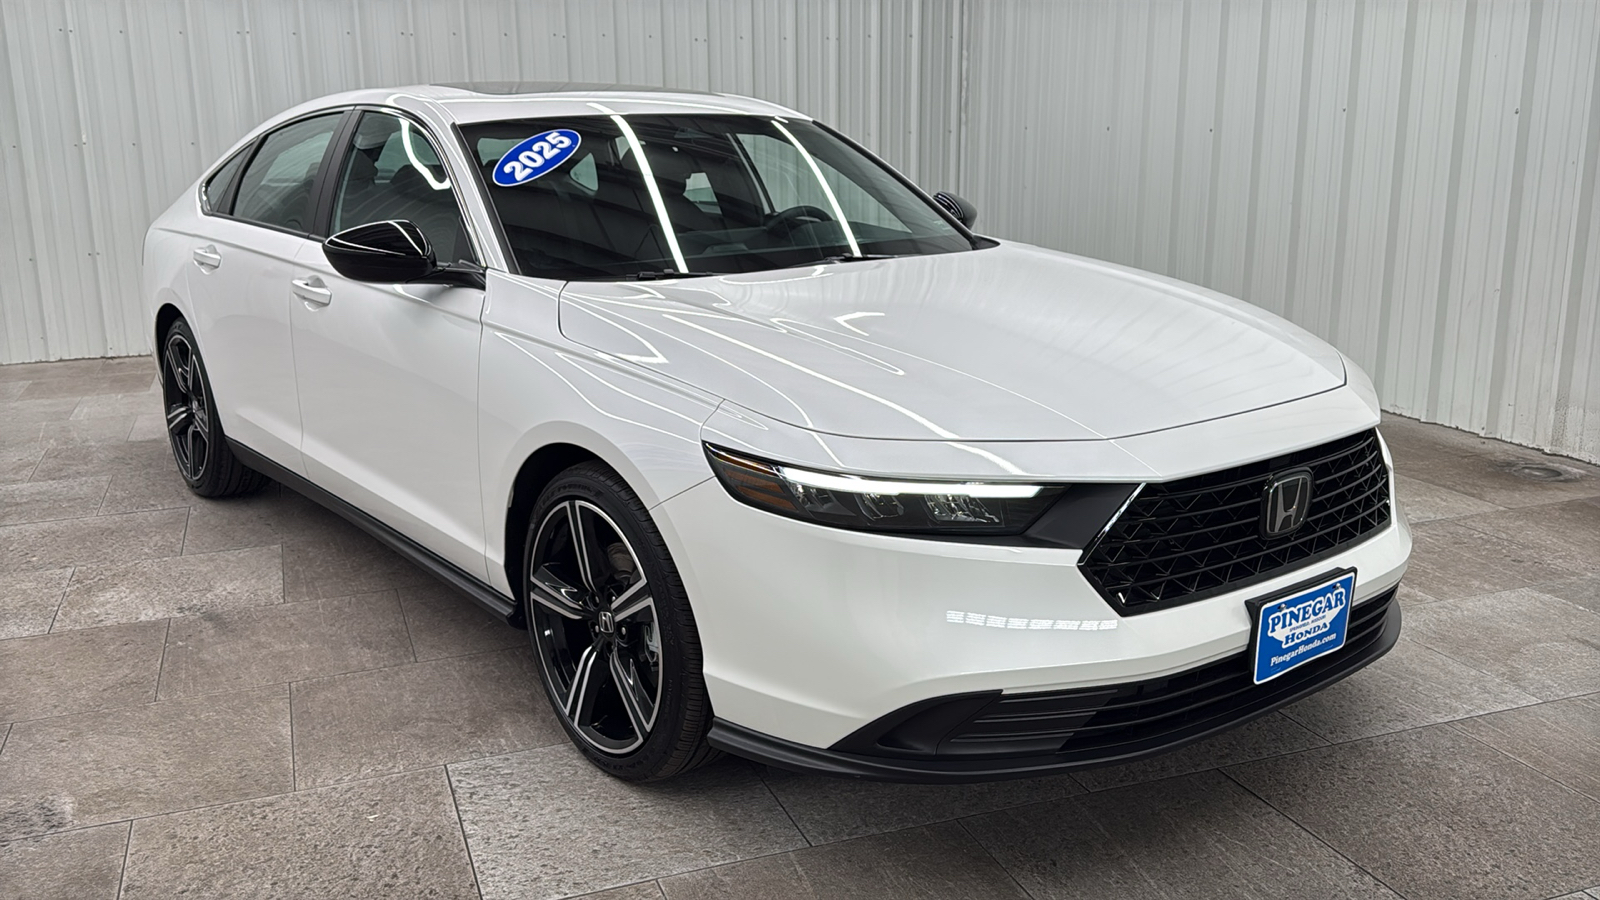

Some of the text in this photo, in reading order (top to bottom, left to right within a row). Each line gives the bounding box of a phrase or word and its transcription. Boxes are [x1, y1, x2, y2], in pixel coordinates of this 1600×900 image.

[503, 131, 572, 182] 2025
[1269, 590, 1345, 634] PINEGAR
[1270, 633, 1337, 667] PinegarHonda.com
[1284, 621, 1329, 646] HONDA
